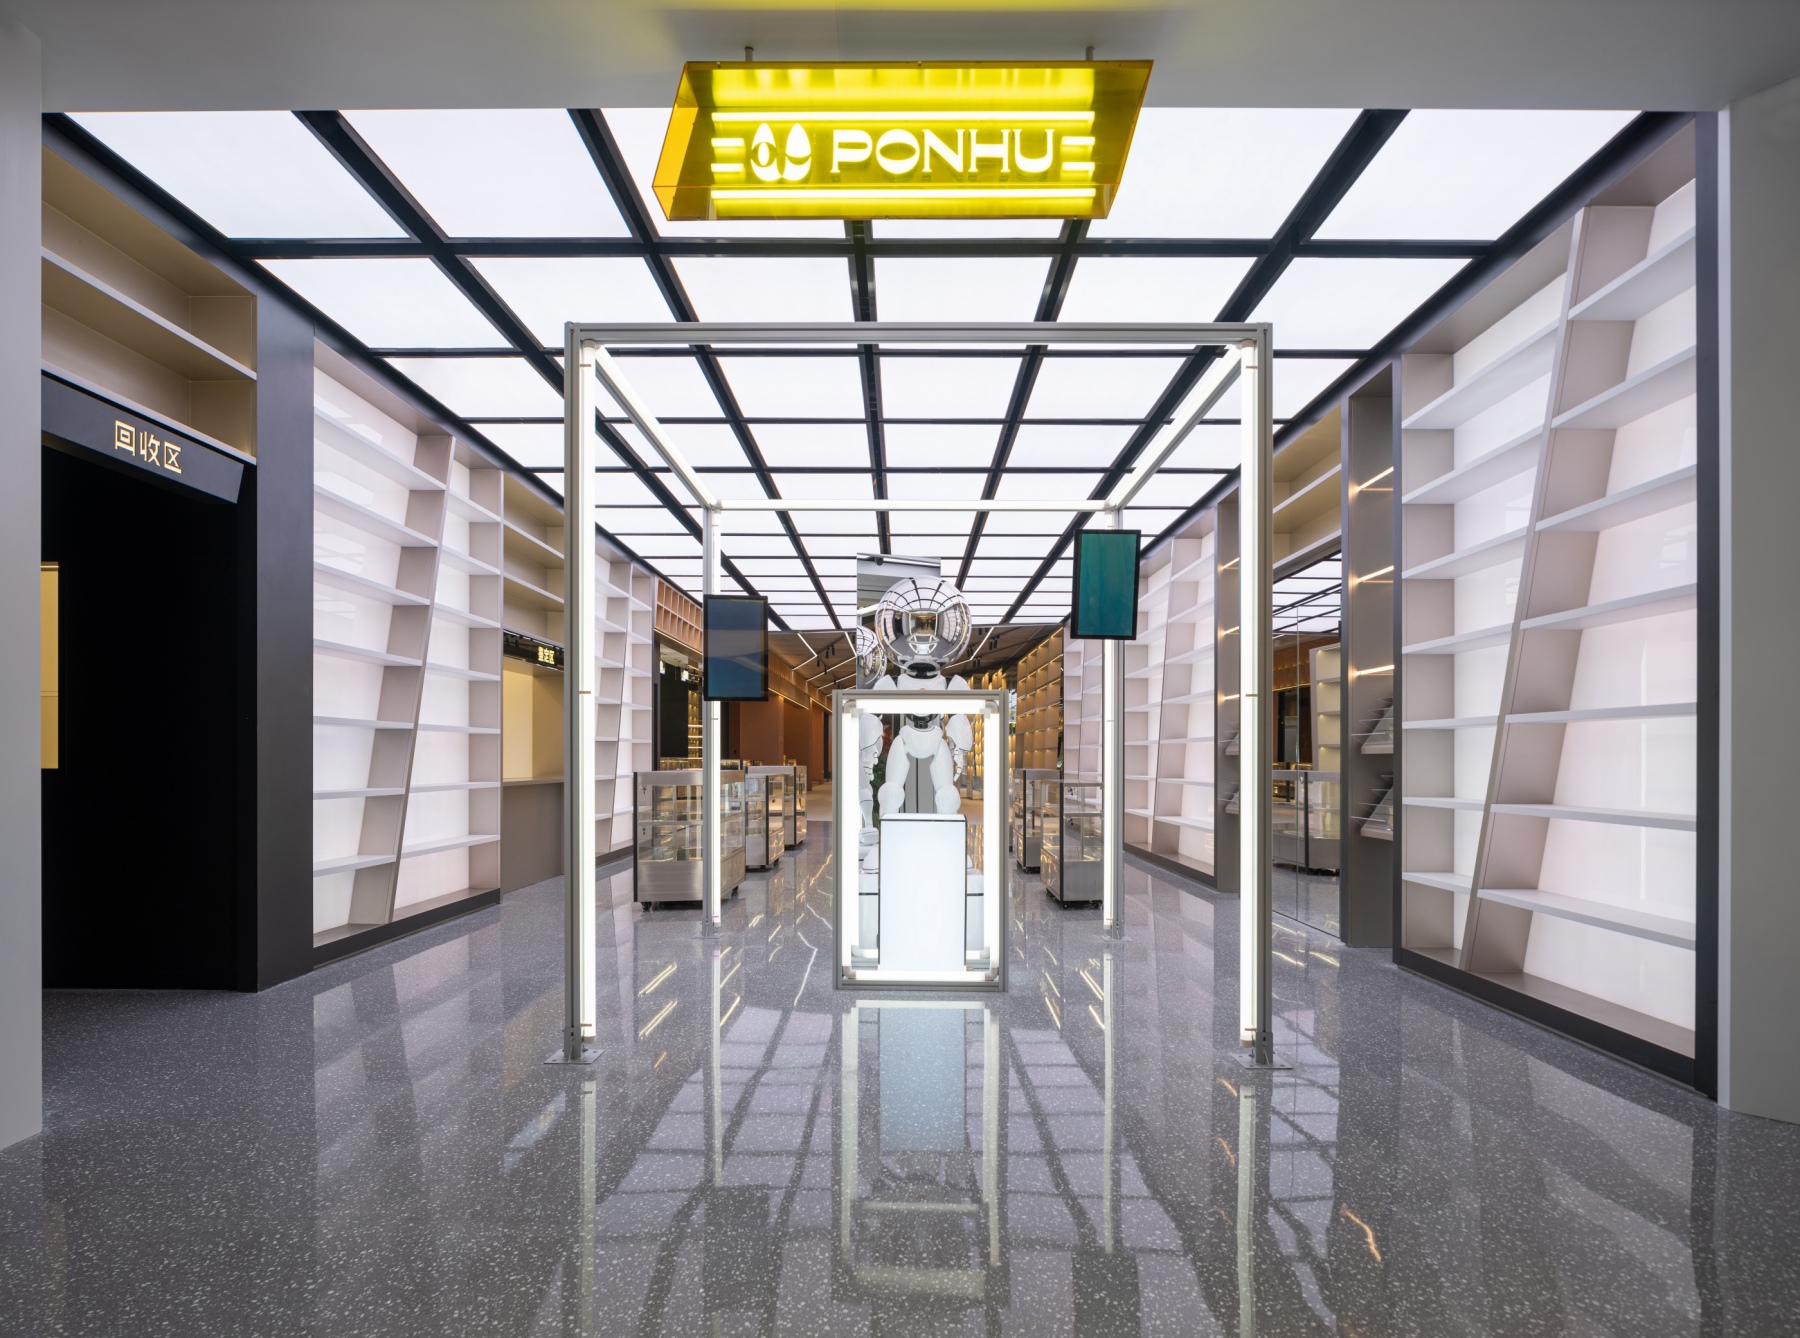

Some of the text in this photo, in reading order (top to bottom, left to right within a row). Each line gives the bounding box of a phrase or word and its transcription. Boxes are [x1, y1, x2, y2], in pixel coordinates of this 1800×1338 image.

[830, 128, 1055, 175] PONHU
[115, 419, 182, 474] 回收区
